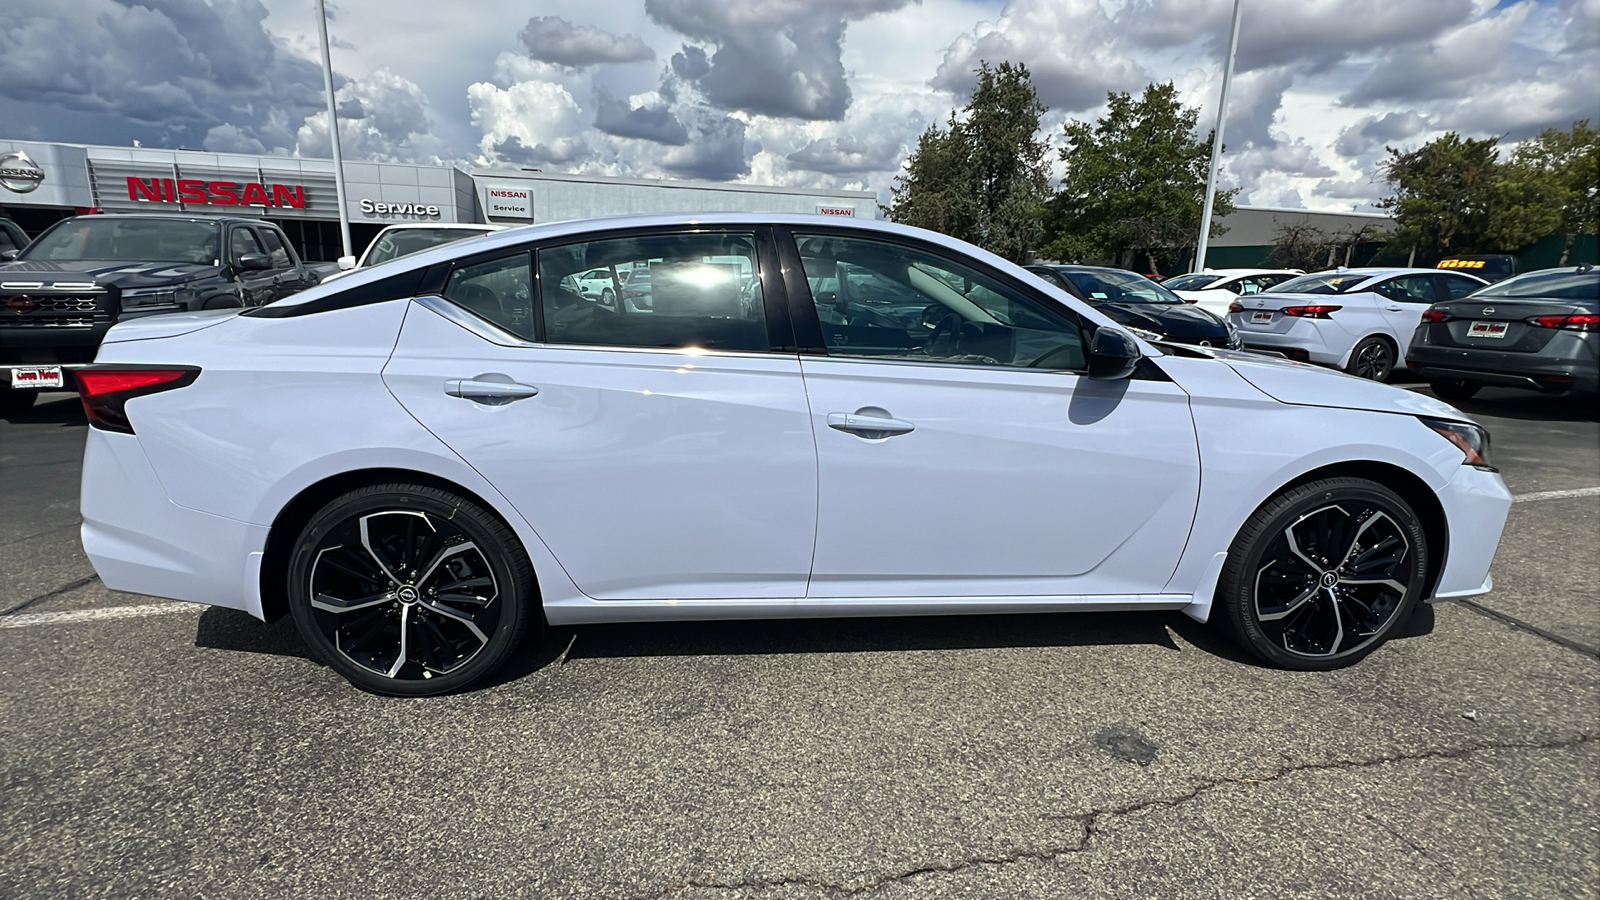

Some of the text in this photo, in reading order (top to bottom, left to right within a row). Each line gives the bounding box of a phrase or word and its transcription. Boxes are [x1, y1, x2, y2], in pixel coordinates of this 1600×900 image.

[0, 168, 38, 179] ISSAN
[126, 176, 305, 209] NISSAN
[490, 190, 527, 198] NISSAN
[360, 198, 440, 216] Service
[493, 204, 526, 212] Service
[821, 208, 851, 216] NISSAN
